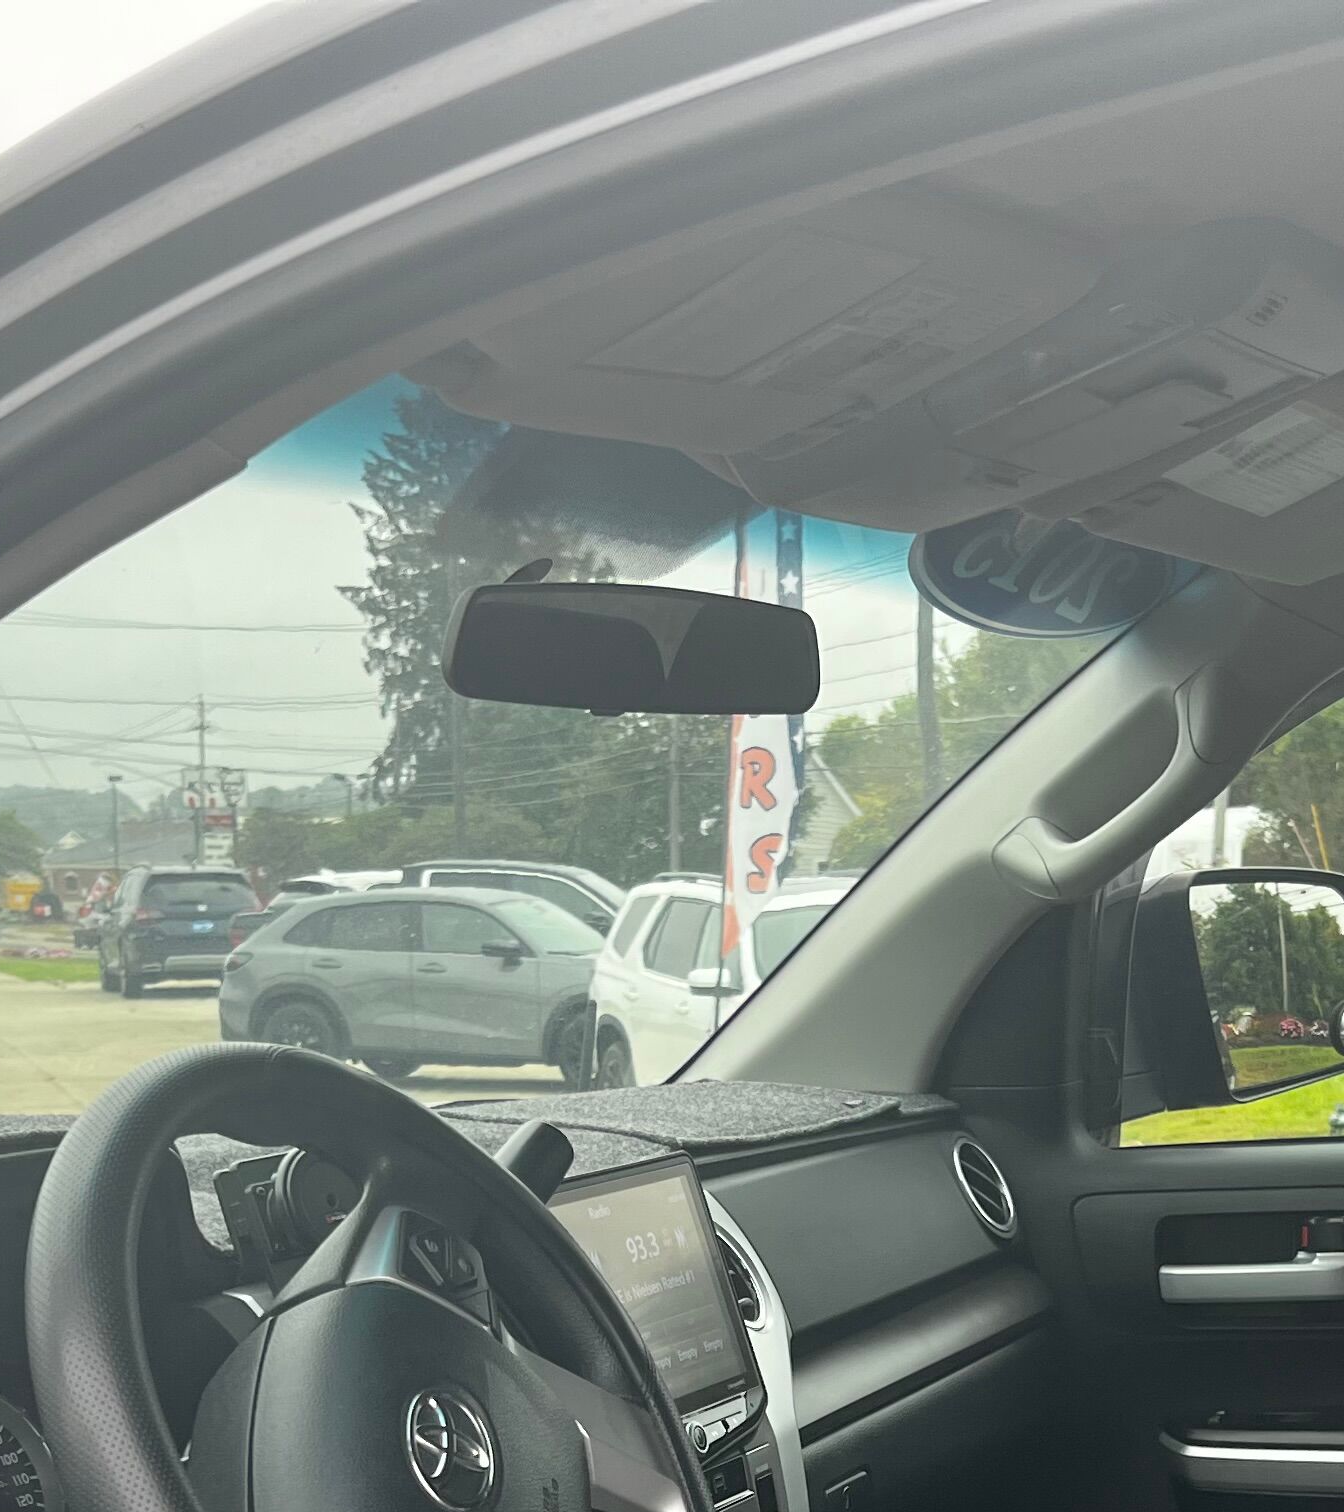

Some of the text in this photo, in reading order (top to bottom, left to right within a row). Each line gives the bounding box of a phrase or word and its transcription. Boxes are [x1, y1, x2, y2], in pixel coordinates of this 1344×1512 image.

[626, 1231, 660, 1263] 93.3
[0, 1452, 19, 1466] 100
[11, 1473, 30, 1487] 110
[16, 1493, 34, 1507] 120
